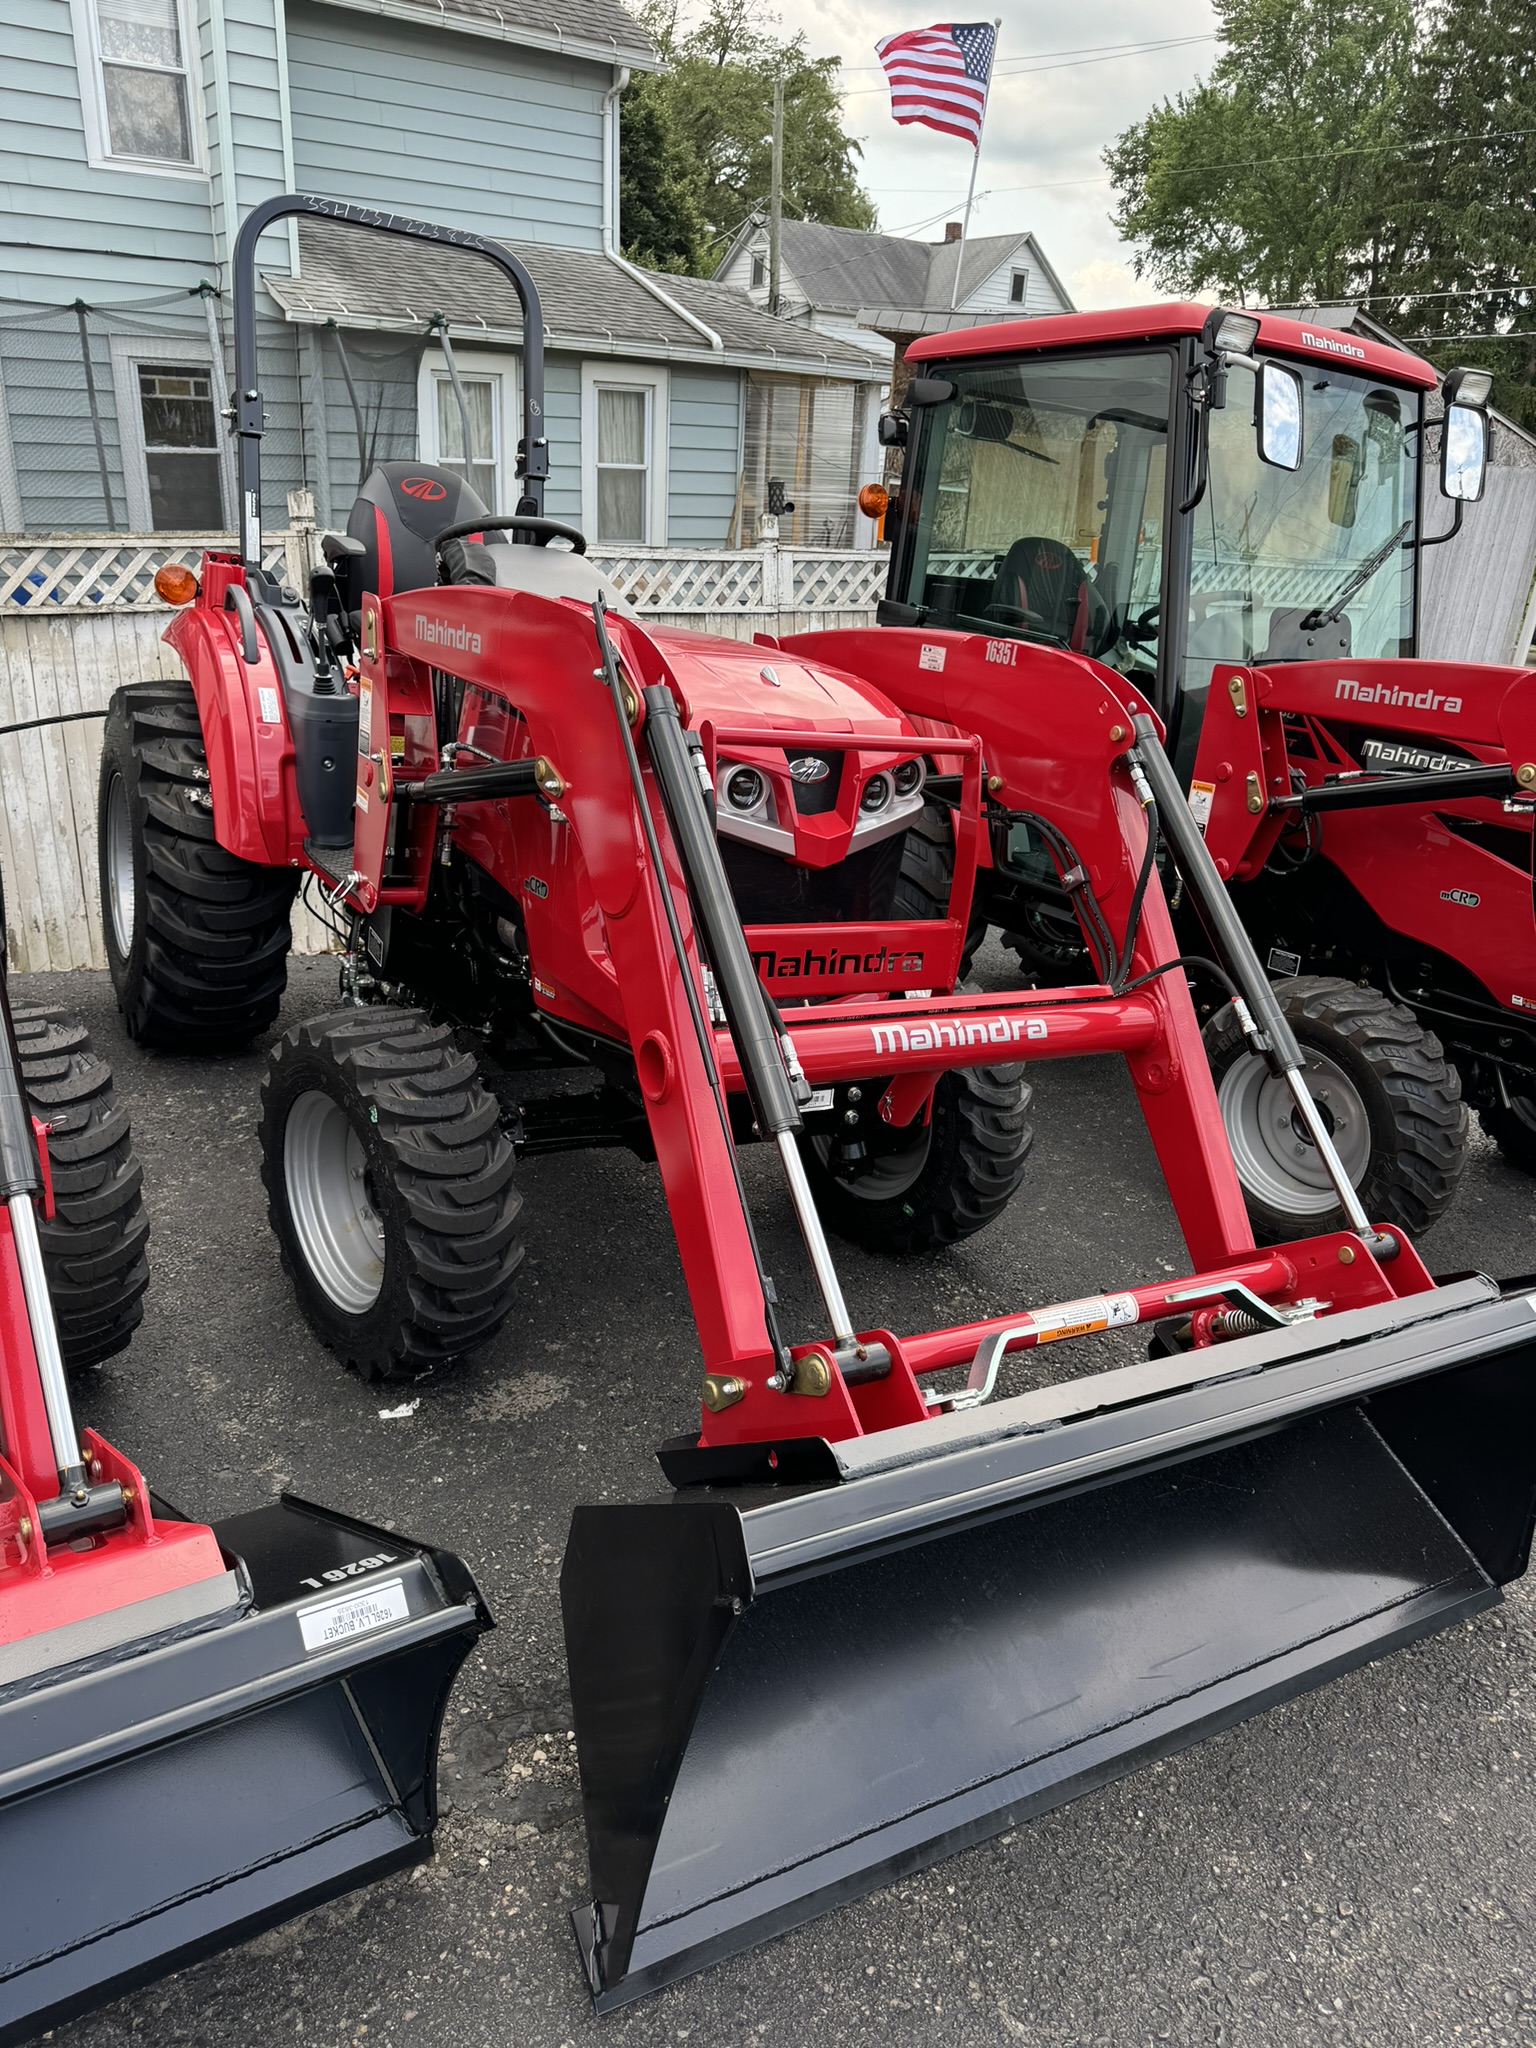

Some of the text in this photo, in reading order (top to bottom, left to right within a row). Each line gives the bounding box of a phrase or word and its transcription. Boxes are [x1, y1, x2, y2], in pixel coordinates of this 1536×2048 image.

[1301, 332, 1365, 358] Mahindra
[415, 614, 482, 655] Mahindra
[1335, 679, 1463, 713] Mahindra
[870, 1016, 1048, 1054] Mahindra
[1056, 1325, 1085, 1337] WARNING
[322, 1553, 398, 1582] 1626
[371, 1607, 393, 1623] 1626L
[323, 1620, 356, 1640] BUCKET
